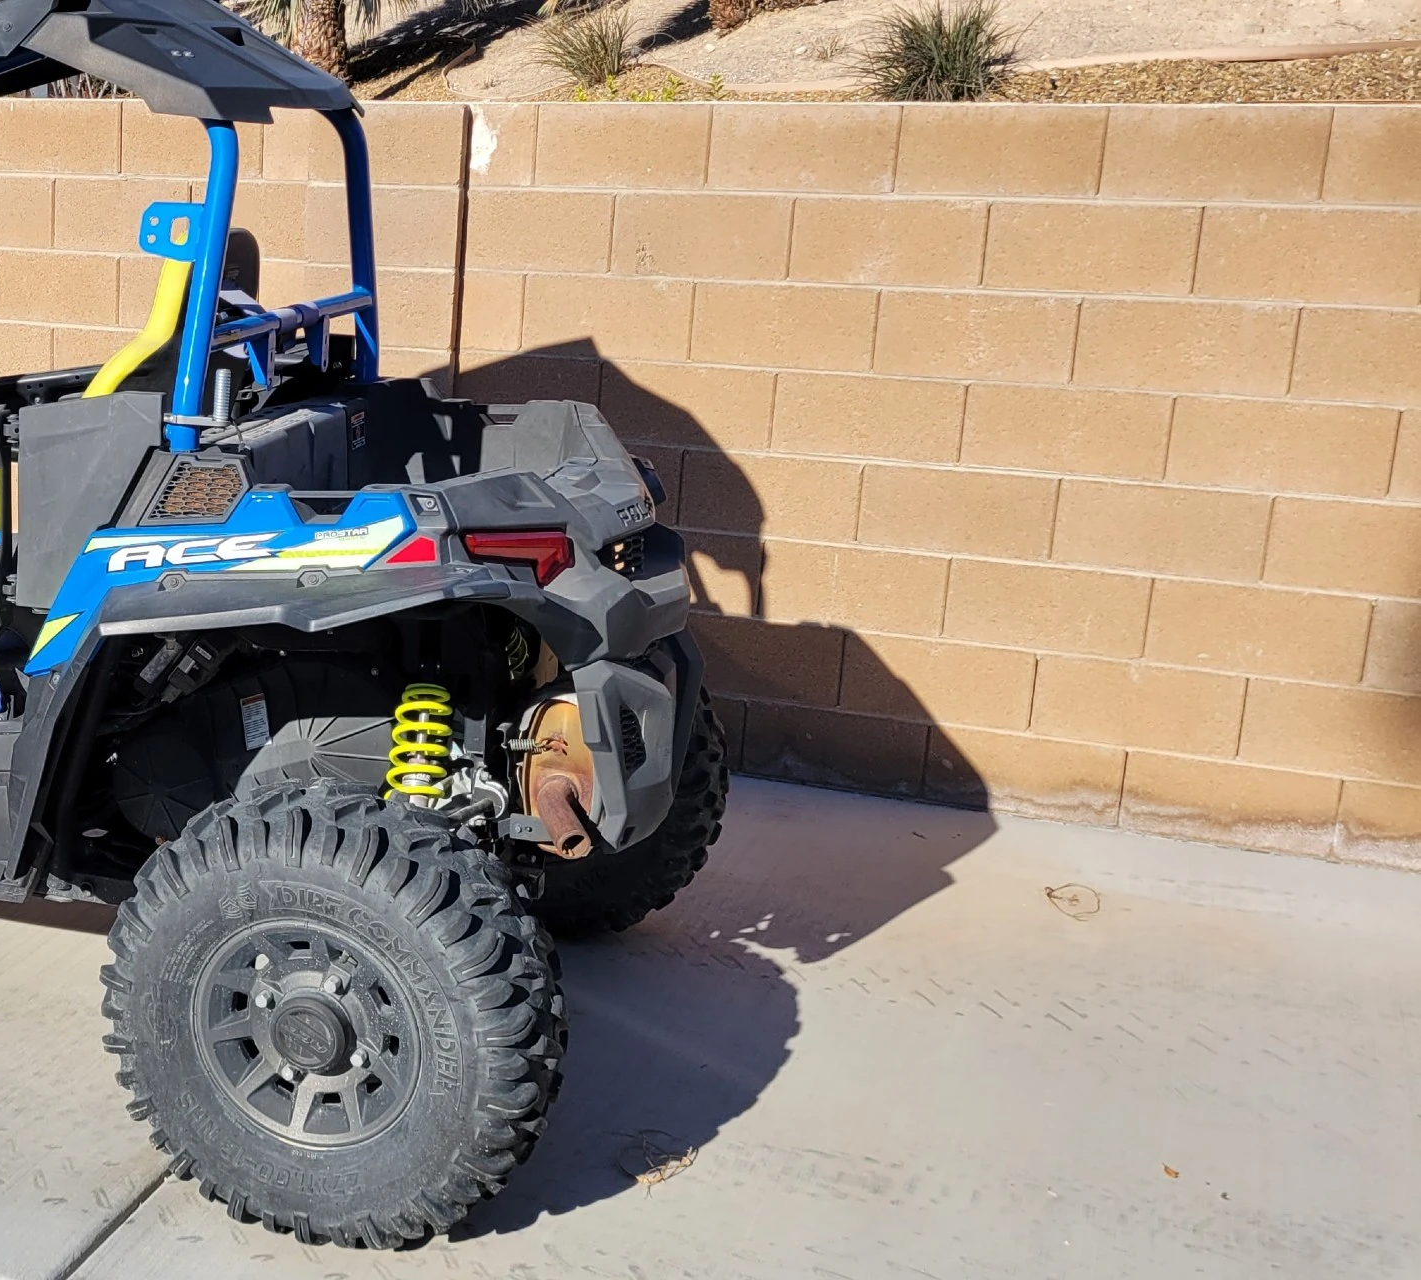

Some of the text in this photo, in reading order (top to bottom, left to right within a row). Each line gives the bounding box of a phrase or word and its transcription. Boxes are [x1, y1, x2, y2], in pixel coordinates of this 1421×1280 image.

[106, 532, 281, 573] ACE
[314, 526, 368, 540] PROSTAR
[276, 885, 344, 915] DIRT
[348, 907, 461, 1097] COMMANDER
